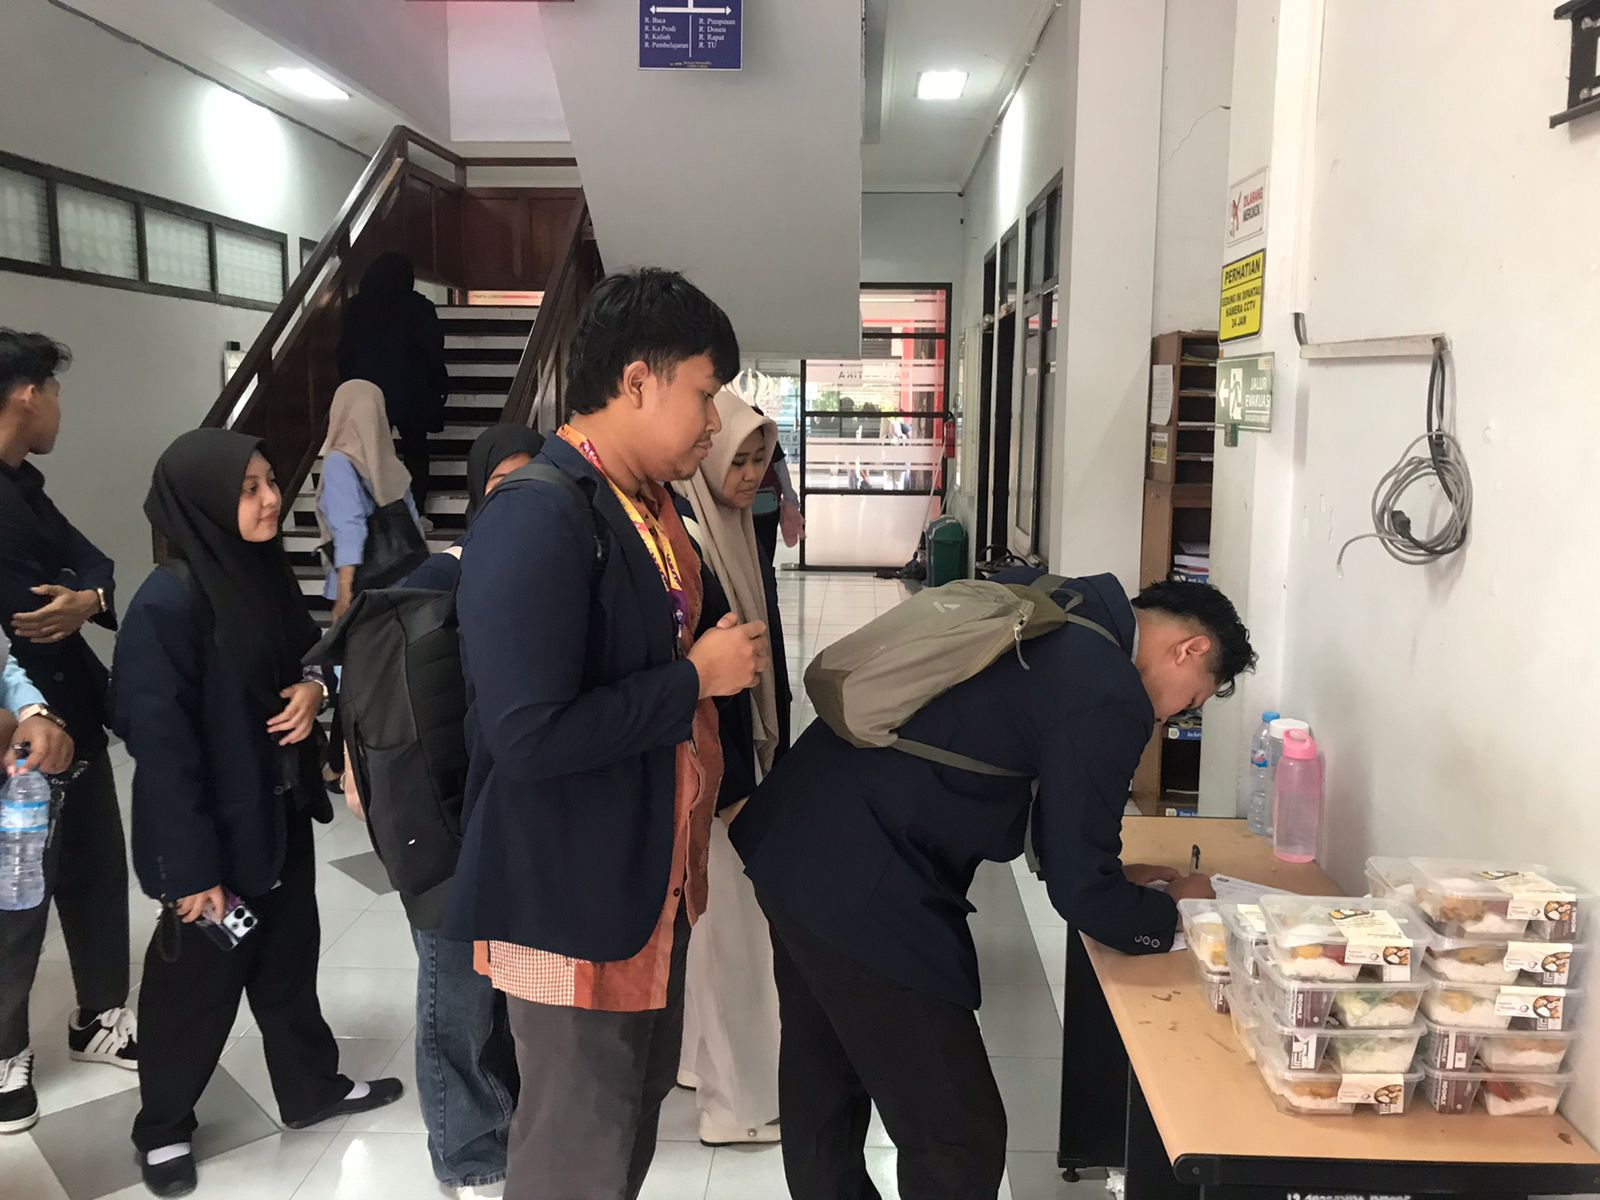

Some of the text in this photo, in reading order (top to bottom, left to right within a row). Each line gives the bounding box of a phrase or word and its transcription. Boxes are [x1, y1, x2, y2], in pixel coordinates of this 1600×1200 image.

[1224, 257, 1261, 285] PERHATIAN
[1226, 300, 1256, 317] KAMERA CCTV
[1237, 315, 1247, 327] JAM
[1250, 377, 1267, 391] JALUR
